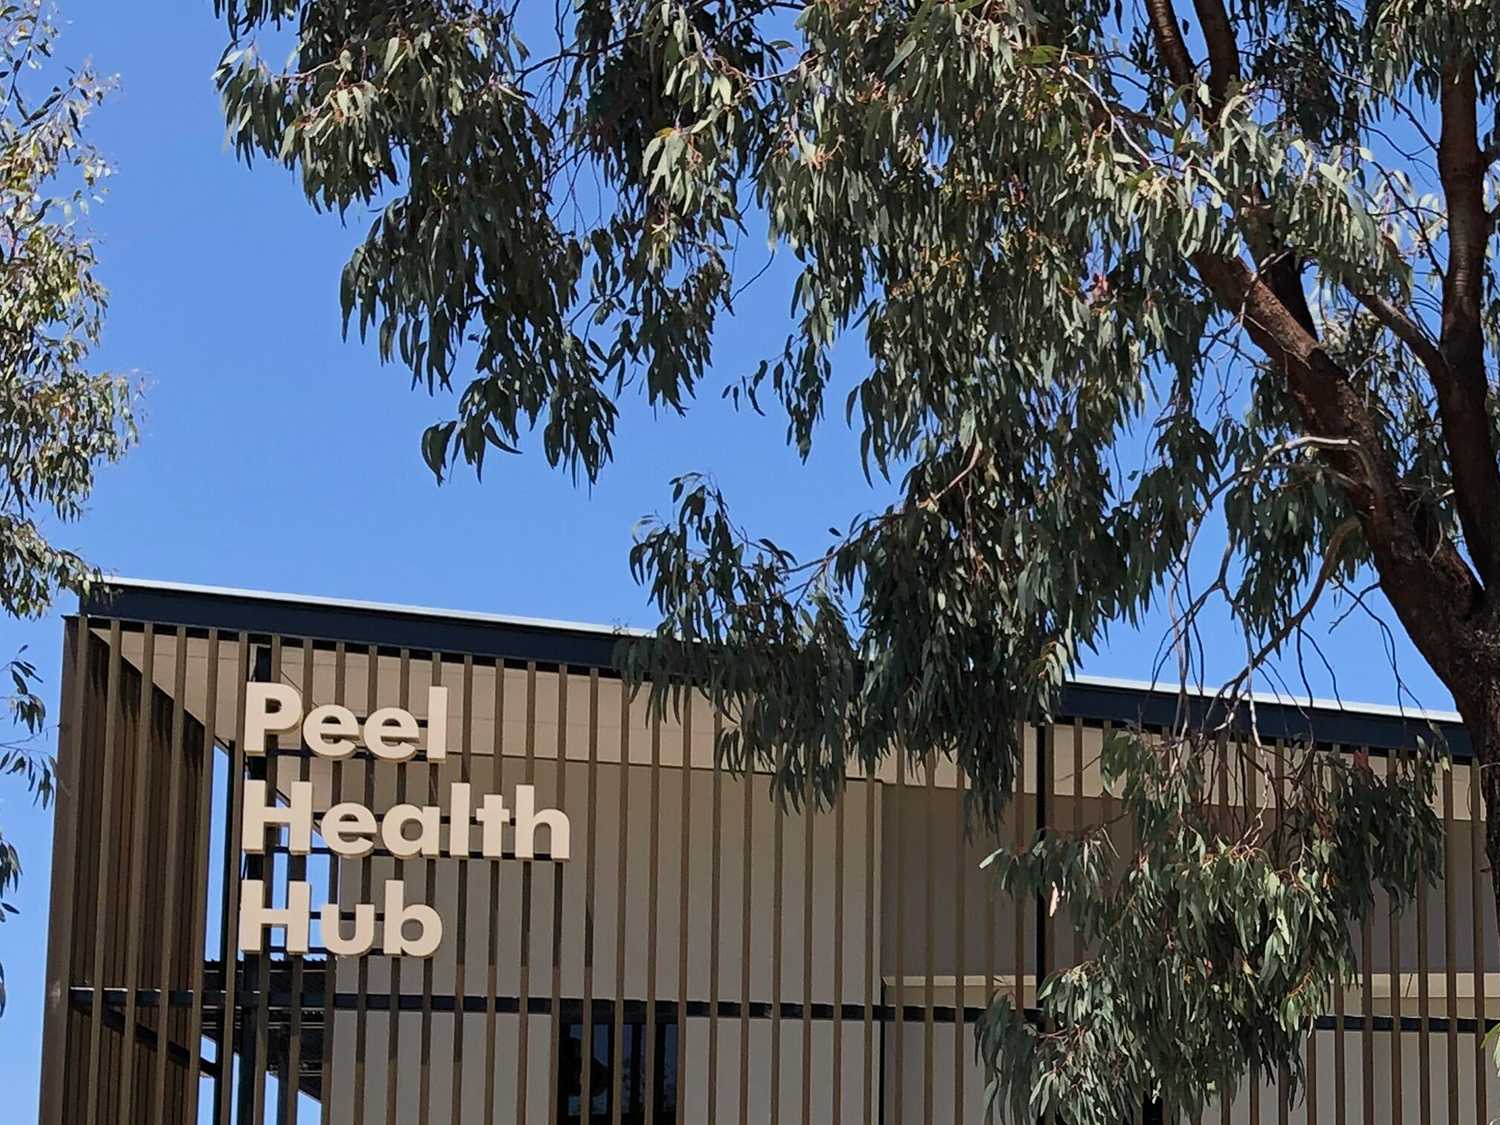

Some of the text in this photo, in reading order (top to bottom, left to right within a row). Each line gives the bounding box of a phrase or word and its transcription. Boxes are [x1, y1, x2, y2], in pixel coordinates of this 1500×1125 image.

[244, 681, 447, 761] Peel
[241, 779, 571, 862] Health
[239, 879, 443, 959] Hub
